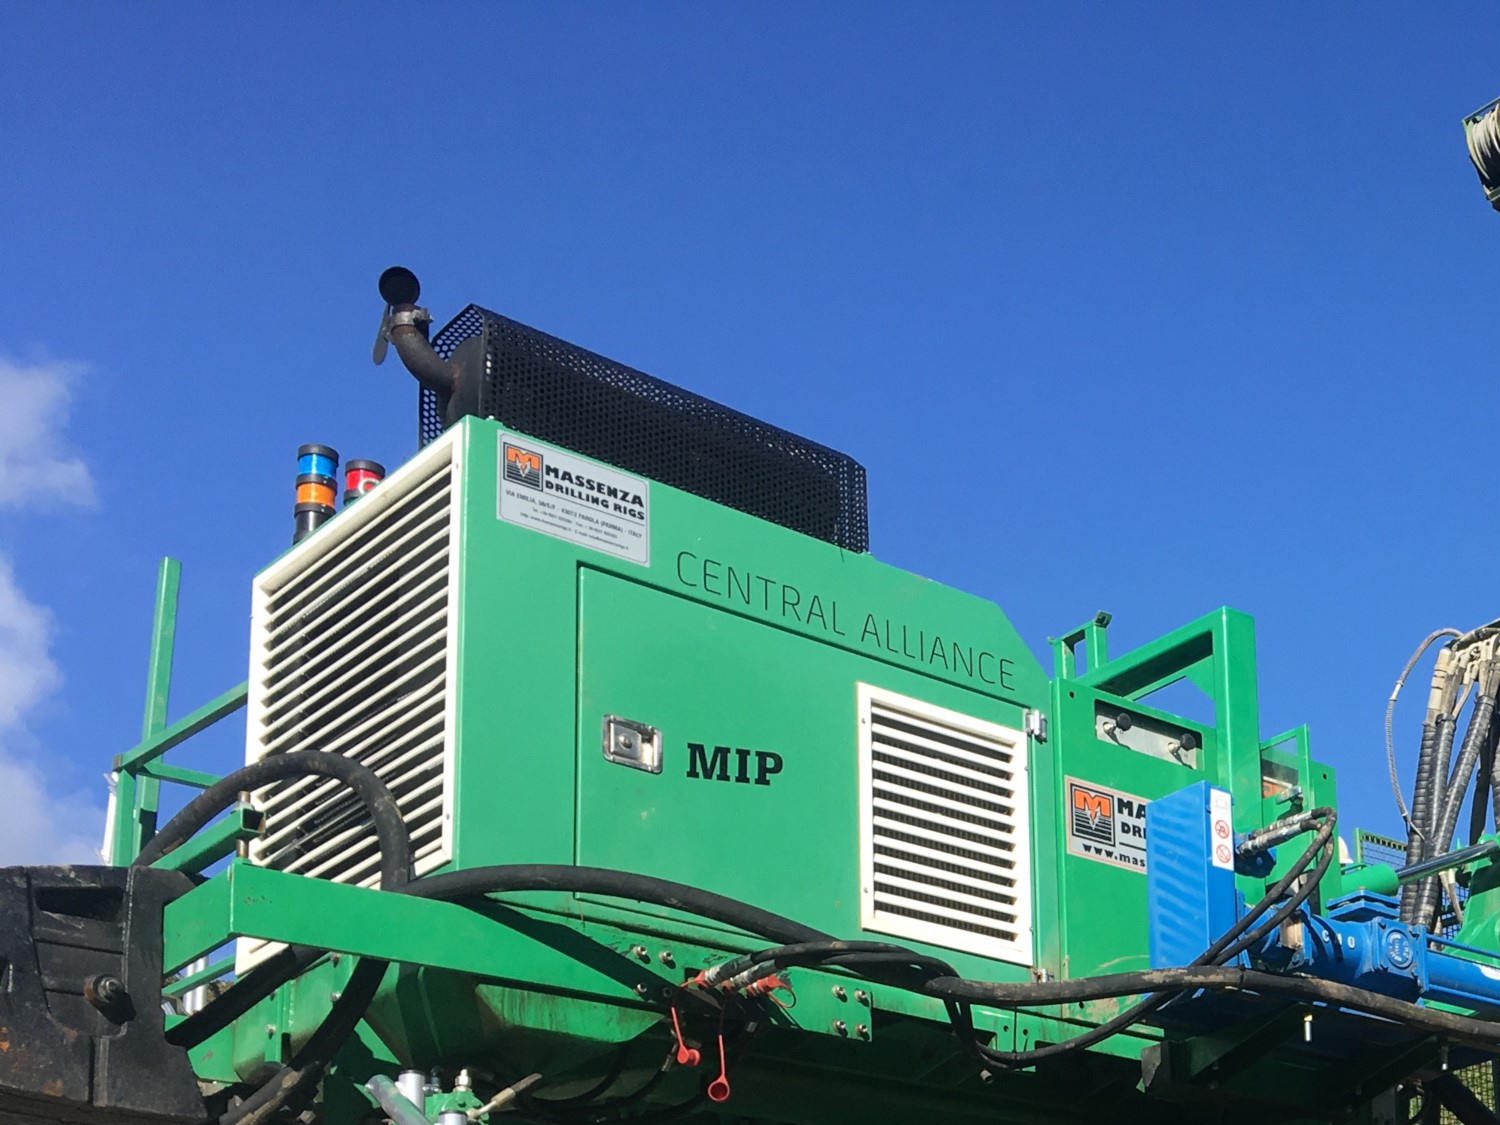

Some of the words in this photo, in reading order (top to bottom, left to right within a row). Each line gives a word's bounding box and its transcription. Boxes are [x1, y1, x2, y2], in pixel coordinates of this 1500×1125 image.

[544, 464, 645, 508] MASSENZA
[544, 480, 610, 509] DRILLING
[613, 502, 645, 521] RIGS
[676, 551, 846, 636] CENTRAL
[860, 613, 1016, 692] ALLIANCE
[686, 742, 784, 786] MIP
